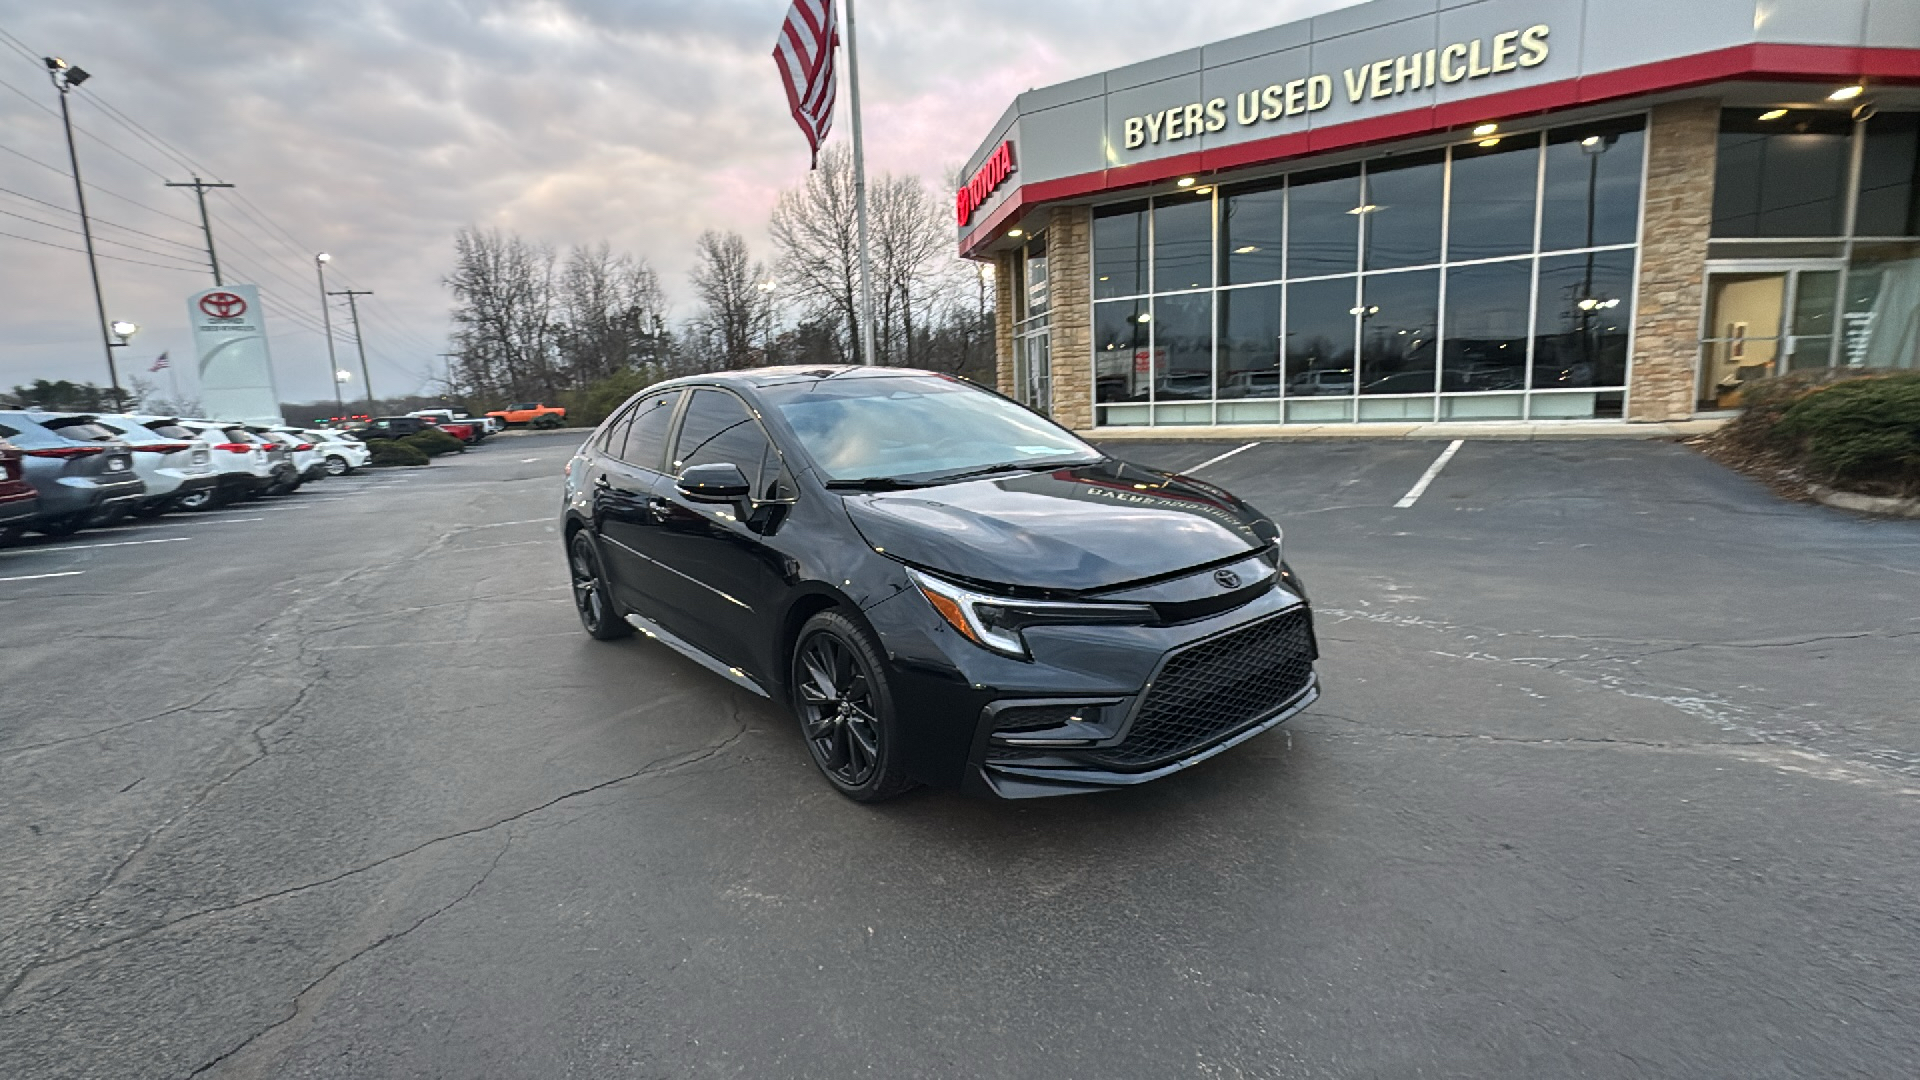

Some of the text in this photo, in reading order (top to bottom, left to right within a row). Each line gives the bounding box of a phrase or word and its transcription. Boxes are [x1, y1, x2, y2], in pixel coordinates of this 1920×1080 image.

[1124, 24, 1550, 150] BYERS USED VEHICLES
[968, 140, 1011, 211] TOYOTA
